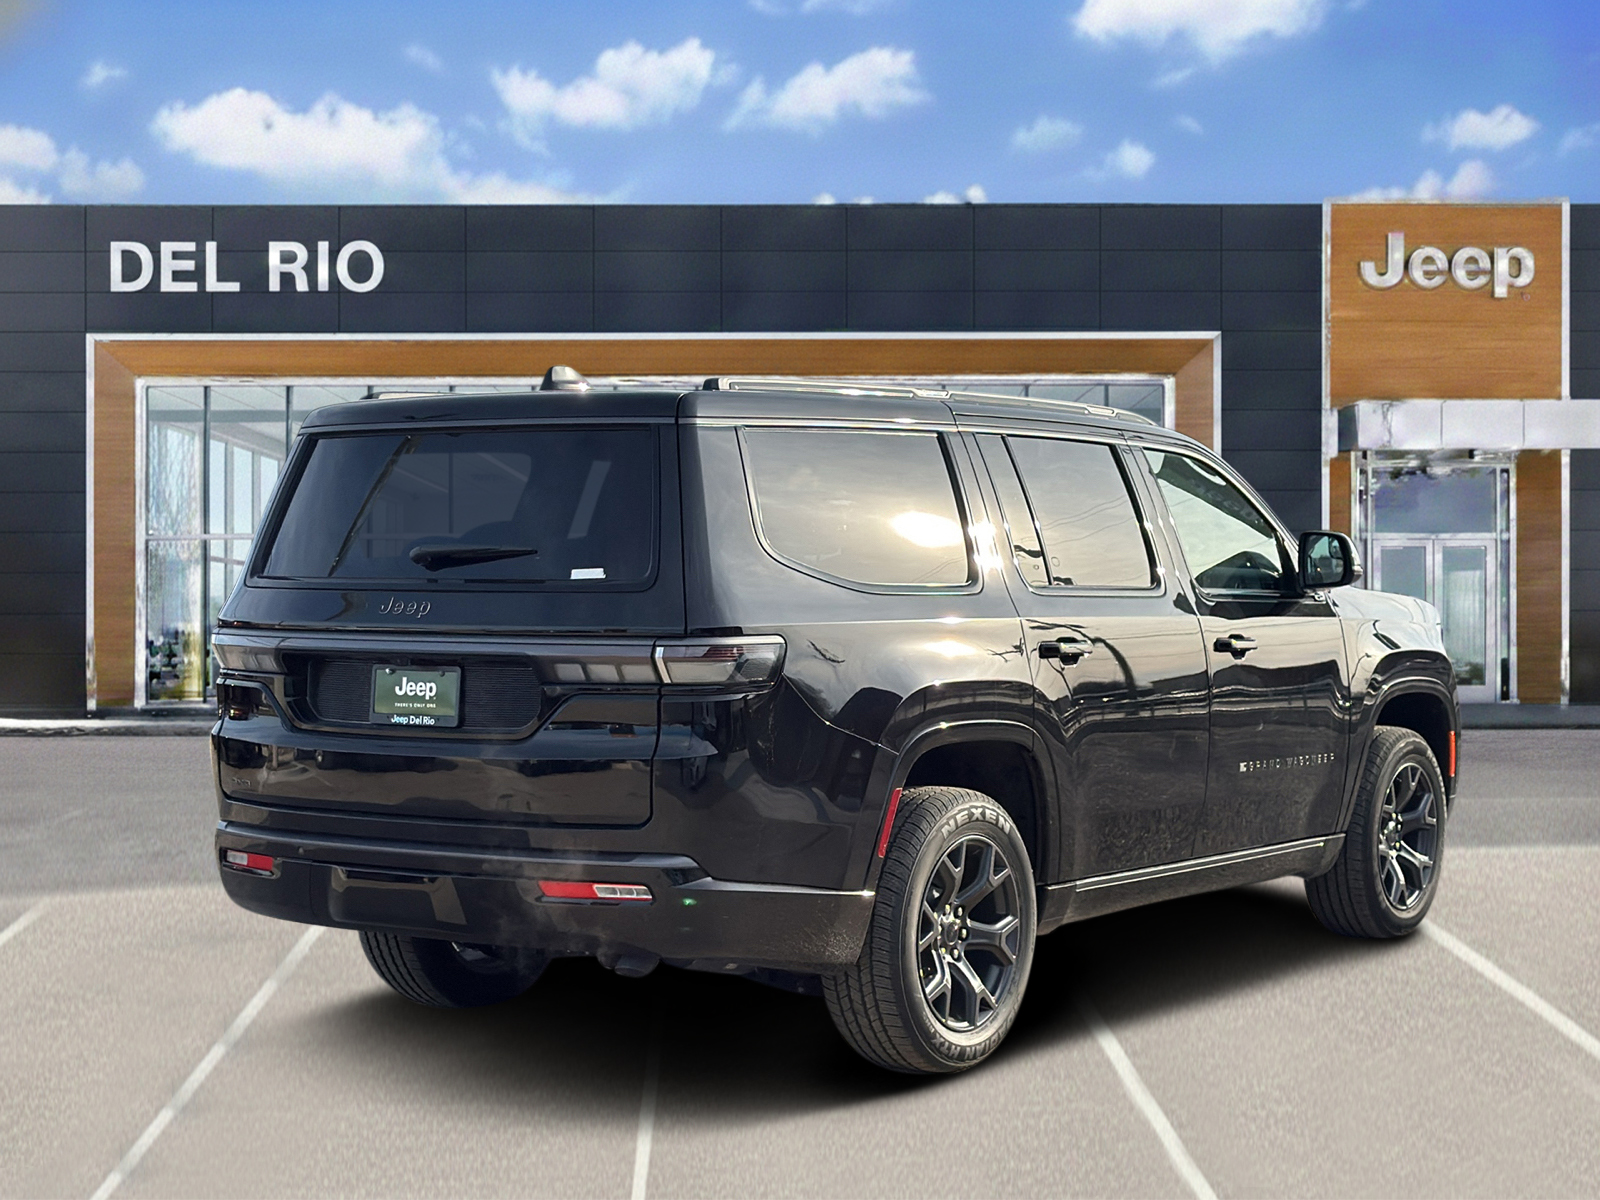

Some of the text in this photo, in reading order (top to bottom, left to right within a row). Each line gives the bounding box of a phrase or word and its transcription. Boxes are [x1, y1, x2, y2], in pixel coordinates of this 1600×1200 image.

[110, 240, 385, 293] DEL RIO
[1359, 231, 1536, 299] Jeep
[379, 597, 431, 618] Jeep
[395, 676, 437, 700] Jeep
[390, 714, 436, 726] Jeep Del Rio
[940, 807, 1011, 840] NEXEN
